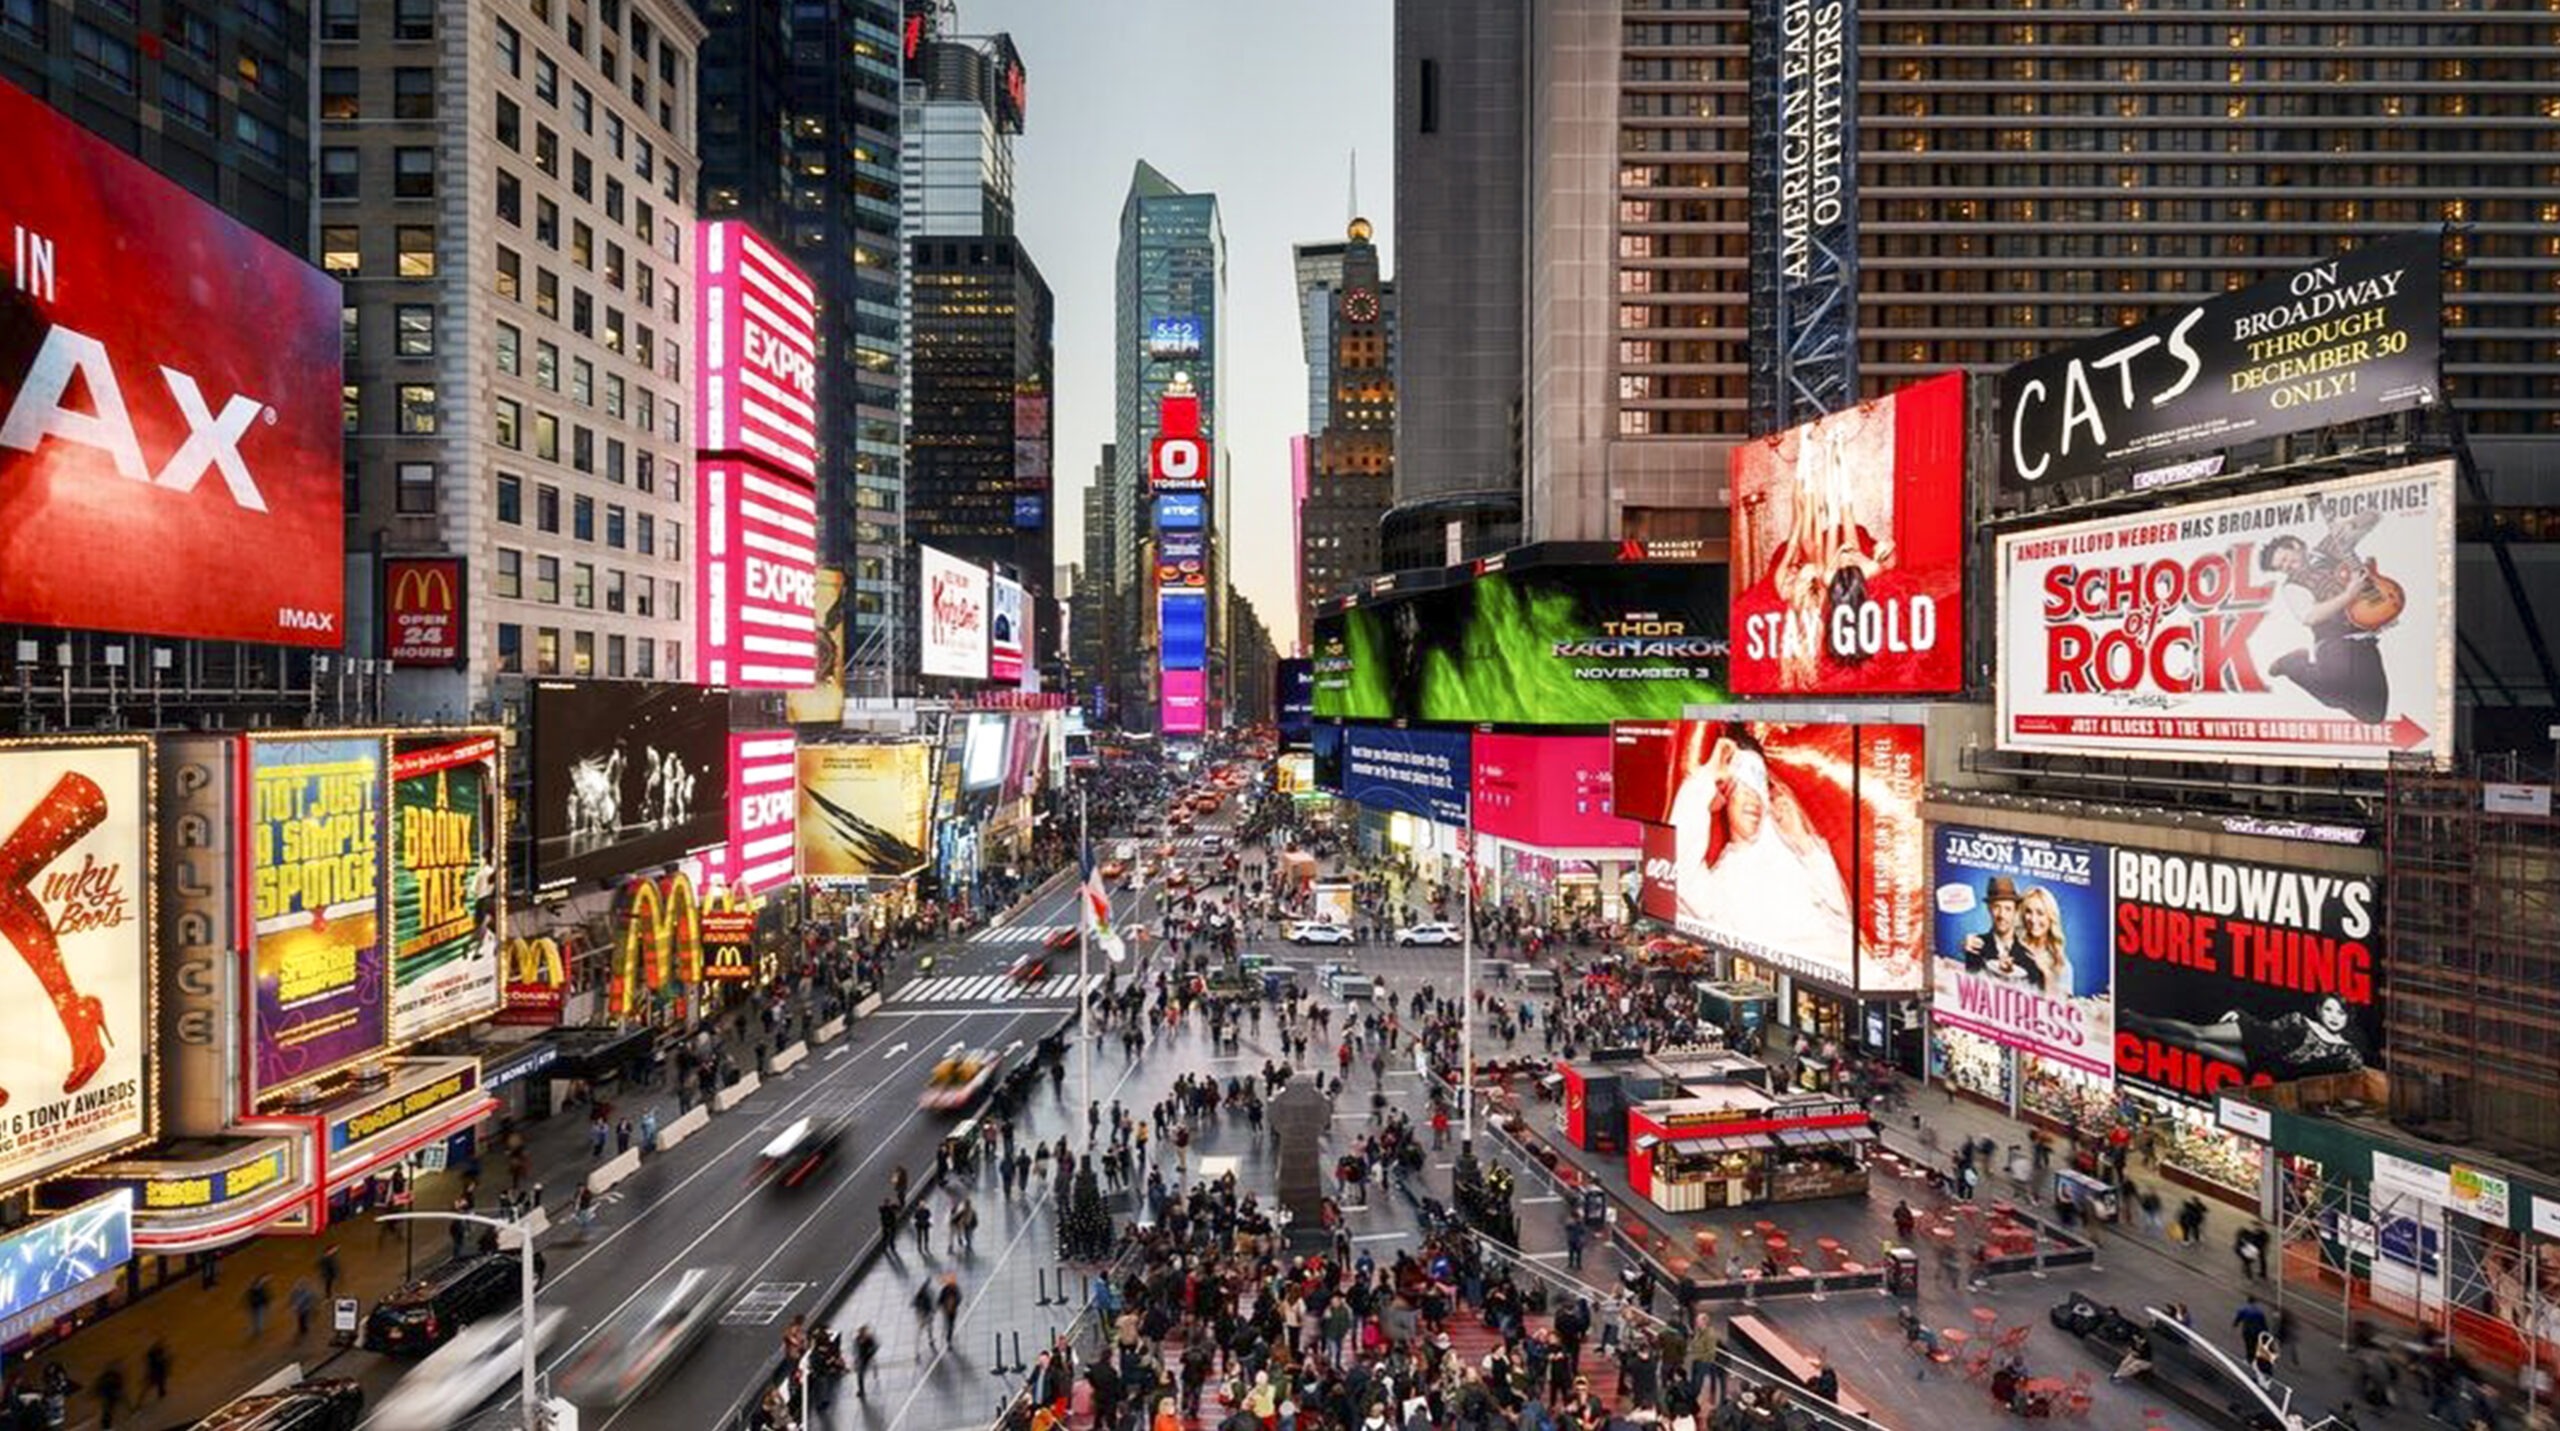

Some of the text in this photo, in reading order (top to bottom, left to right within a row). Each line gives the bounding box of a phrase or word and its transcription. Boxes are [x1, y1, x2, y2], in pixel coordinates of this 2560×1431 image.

[1813, 1, 1843, 226] OUTFITTERS
[1783, 89, 1809, 279] AMERICAN
[14, 225, 55, 303] IN
[2289, 261, 2341, 297] ON
[2232, 269, 2405, 342] BROADWAY
[2246, 306, 2388, 362] THROUGH
[2230, 339, 2371, 395] DECEMBER
[2376, 330, 2408, 359] 30
[2012, 306, 2205, 481] CATS
[2270, 371, 2358, 409] ONLY!
[1153, 480, 1206, 489] TOSHIBA
[1648, 540, 1704, 549] MARRIOTT
[1648, 549, 1698, 558] MARQUIS
[2016, 539, 2069, 562] ANDREW
[2072, 531, 2114, 555] LLOYD
[2118, 522, 2179, 548] WEBBER
[2180, 517, 2213, 540] HAS
[2217, 498, 2320, 537] BROADWAY
[2043, 541, 2276, 622] SCHOOL
[278, 608, 334, 632] IMAX
[398, 614, 448, 626] OPEN
[403, 628, 443, 644] 24
[1603, 621, 1686, 636] THOR
[1746, 595, 1936, 660] STAY GOLD
[2124, 603, 2161, 642] of
[392, 647, 455, 659] HOURS
[1551, 637, 1730, 659] RAGNAROK
[2044, 612, 2271, 695] ROCK
[1574, 667, 1710, 679] NOVEMBER 3
[2071, 716, 2393, 744] JUST 4 BLOCKS TO THE WINTER GARDEN THEATRE
[310, 773, 374, 818] JUST
[436, 769, 448, 808] A
[403, 805, 471, 869] BRONX
[1946, 837, 2091, 876] JASON MRAZ
[177, 762, 214, 1045] PALACE
[256, 850, 376, 919] SPONGE
[418, 866, 467, 930] TALE
[2117, 850, 2372, 940] BROADWAY'S
[1770, 950, 1852, 984] OUTFITTERS
[2117, 902, 2372, 1005] SURE THING
[1956, 972, 2084, 1047] WAITRESS
[501, 1061, 533, 1083] MONEY
[12, 1114, 23, 1135] 6
[27, 1098, 71, 1130] TONY
[74, 1078, 136, 1116] AWARDS
[17, 1122, 62, 1147] BEST
[65, 1100, 136, 1130] MUSICAL
